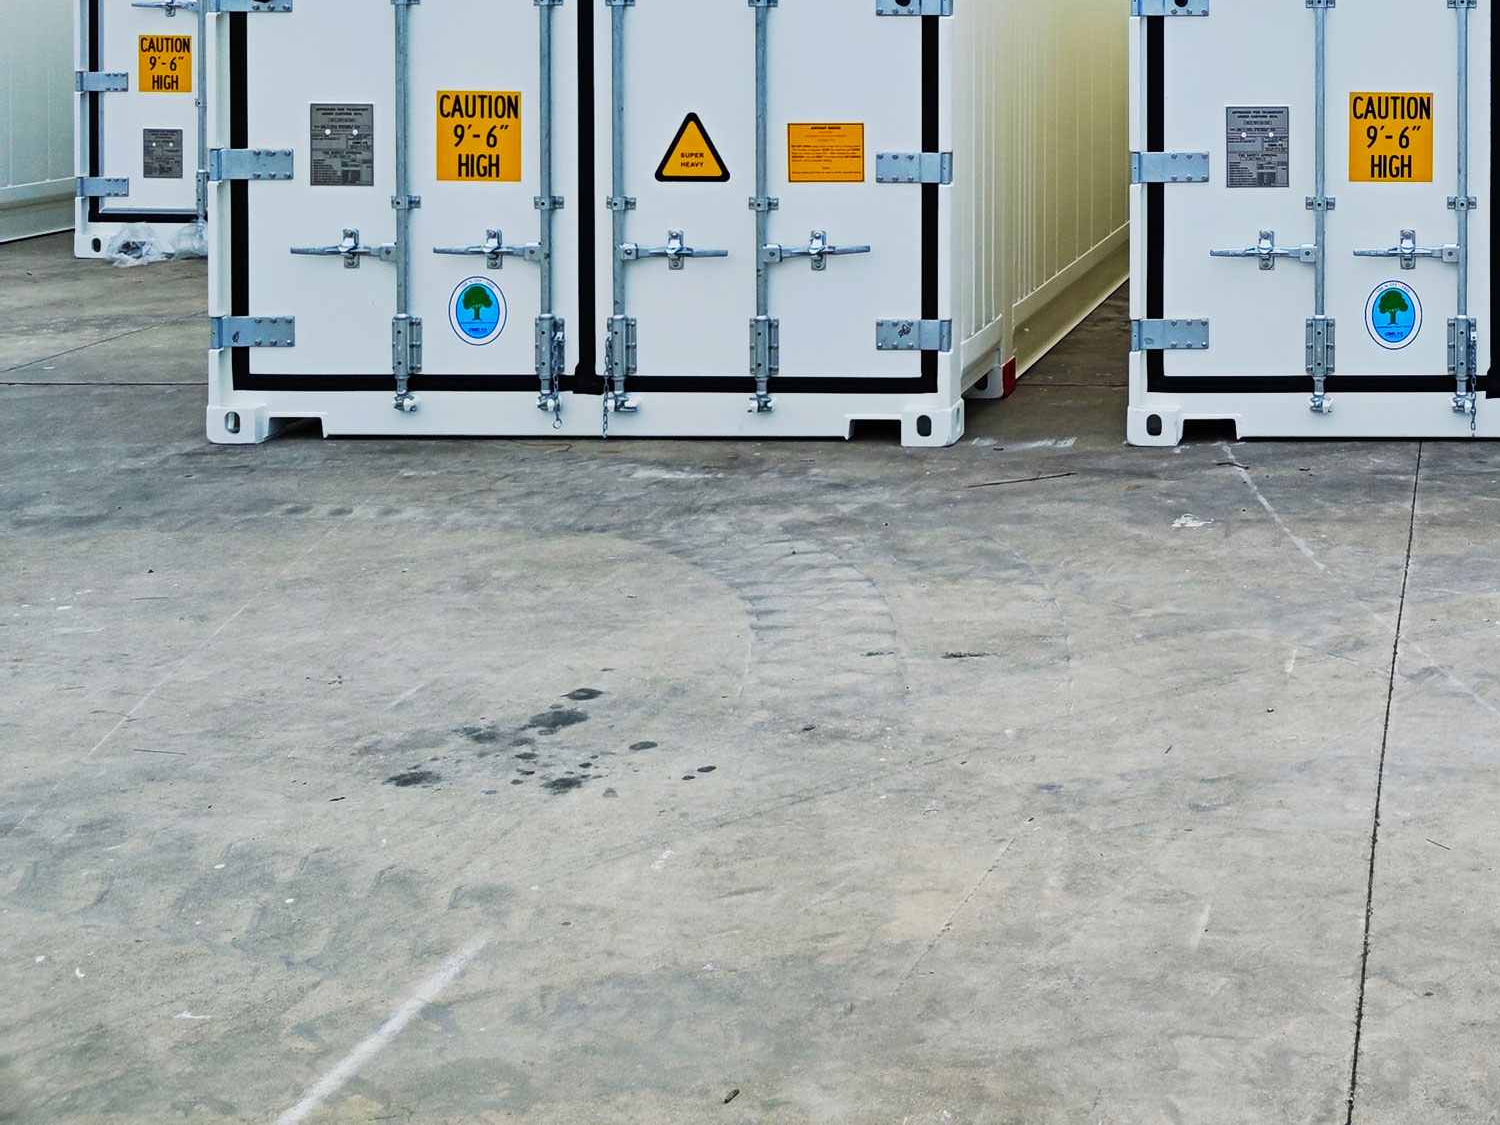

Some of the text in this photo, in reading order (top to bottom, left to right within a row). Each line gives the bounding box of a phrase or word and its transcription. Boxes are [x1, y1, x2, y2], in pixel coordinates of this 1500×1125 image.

[140, 37, 191, 53] CAUTION
[152, 75, 179, 91] HIGH
[440, 95, 518, 118] CAUTION
[1353, 97, 1430, 119] CAUTION
[458, 154, 499, 177] HIGH
[1371, 155, 1411, 178] HIGH
